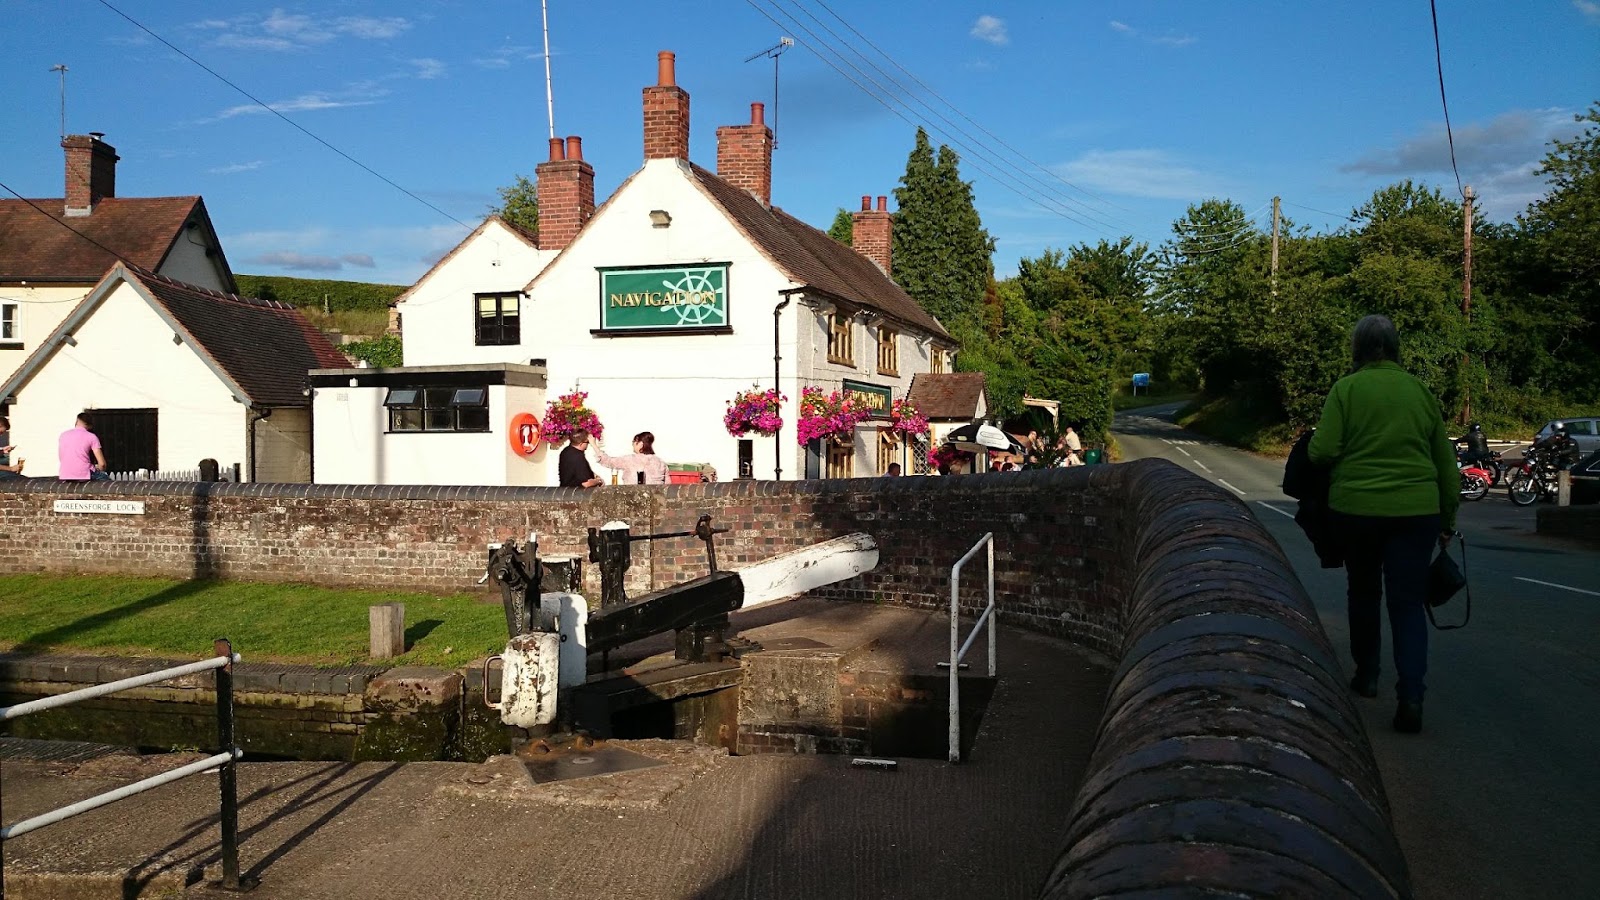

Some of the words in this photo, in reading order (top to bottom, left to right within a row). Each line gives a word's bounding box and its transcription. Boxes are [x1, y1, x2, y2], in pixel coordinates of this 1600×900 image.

[610, 290, 717, 307] NAVIGATION
[60, 503, 111, 511] GREENSFORGE
[116, 504, 137, 512] LOCK
